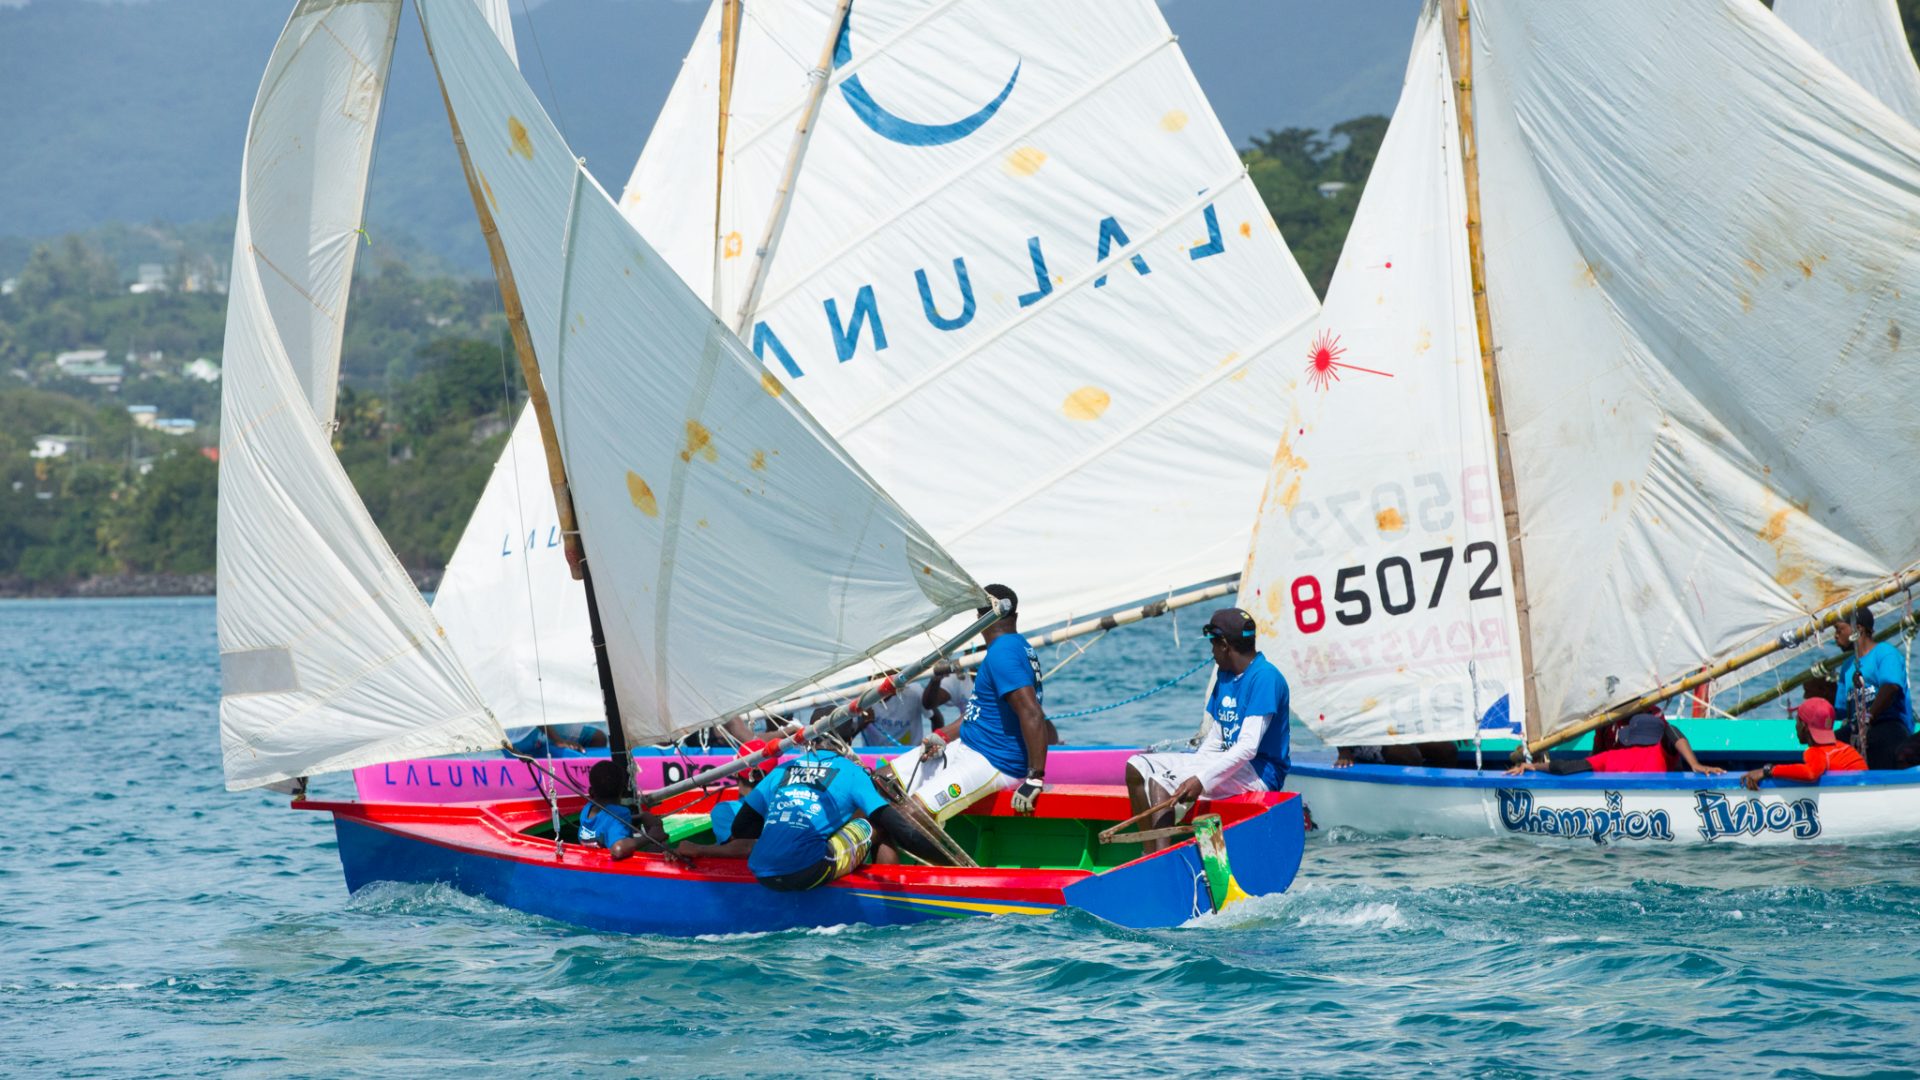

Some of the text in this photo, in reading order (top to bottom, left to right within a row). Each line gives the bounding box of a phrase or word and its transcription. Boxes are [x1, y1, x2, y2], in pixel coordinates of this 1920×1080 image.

[1290, 540, 1503, 634] 85072
[385, 763, 514, 787] LALUNA
[1496, 787, 1675, 845] Champion
